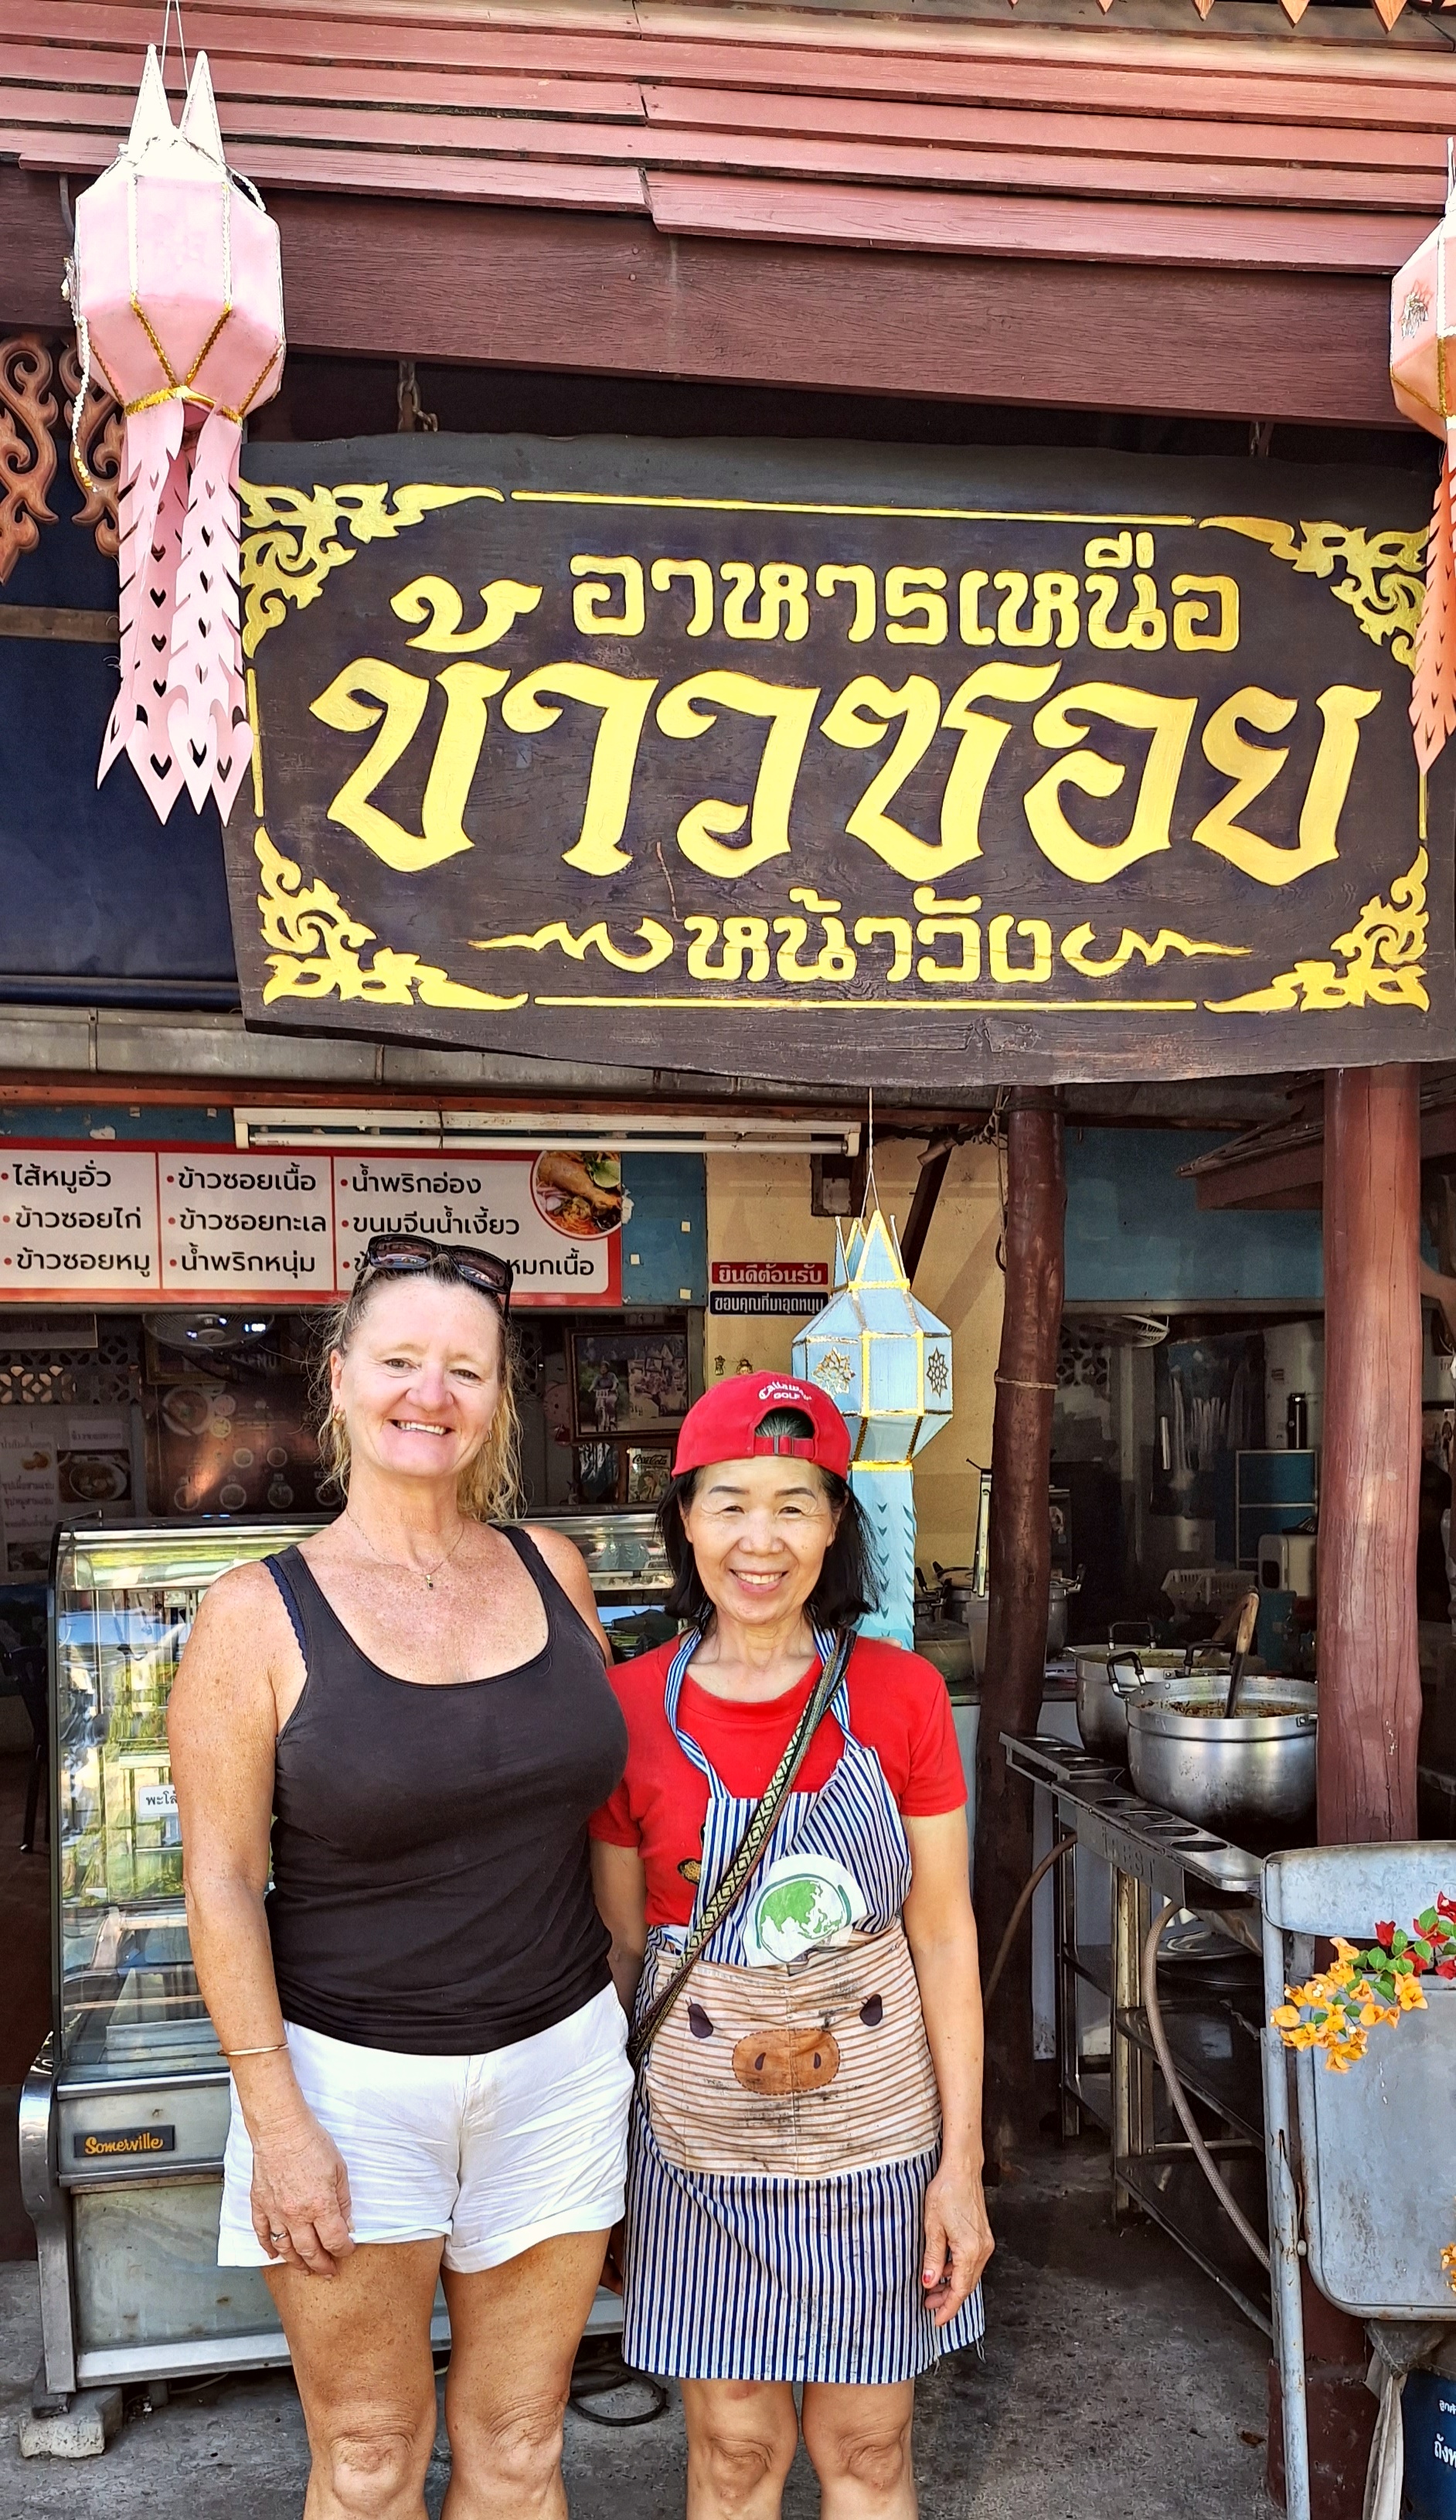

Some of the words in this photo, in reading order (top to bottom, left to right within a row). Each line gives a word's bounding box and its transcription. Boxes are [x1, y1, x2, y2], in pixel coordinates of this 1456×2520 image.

[571, 532, 1239, 651] อาหารเหนือ
[310, 576, 1381, 886] ข้าวซอย
[685, 885, 1053, 984] หน้าวัง
[12, 1160, 111, 1194] ไส้หมูอั่ว
[179, 1162, 316, 1191] ข้าวซอยเนื้อ
[352, 1163, 481, 1194] น้ำพริกอ่อง
[15, 1205, 141, 1229] ข้าวซอยไก่
[179, 1207, 326, 1232] ข้าวซอยทะเล
[353, 1205, 520, 1234] ขนมจีนน้ำเงี้ยว
[17, 1247, 150, 1277] ข้าวซอยหมู
[182, 1242, 315, 1279] น้ำพริกหนุ่ม
[719, 1263, 822, 1283] ยินดีต้อนรับ
[85, 2132, 164, 2154] Somerville
